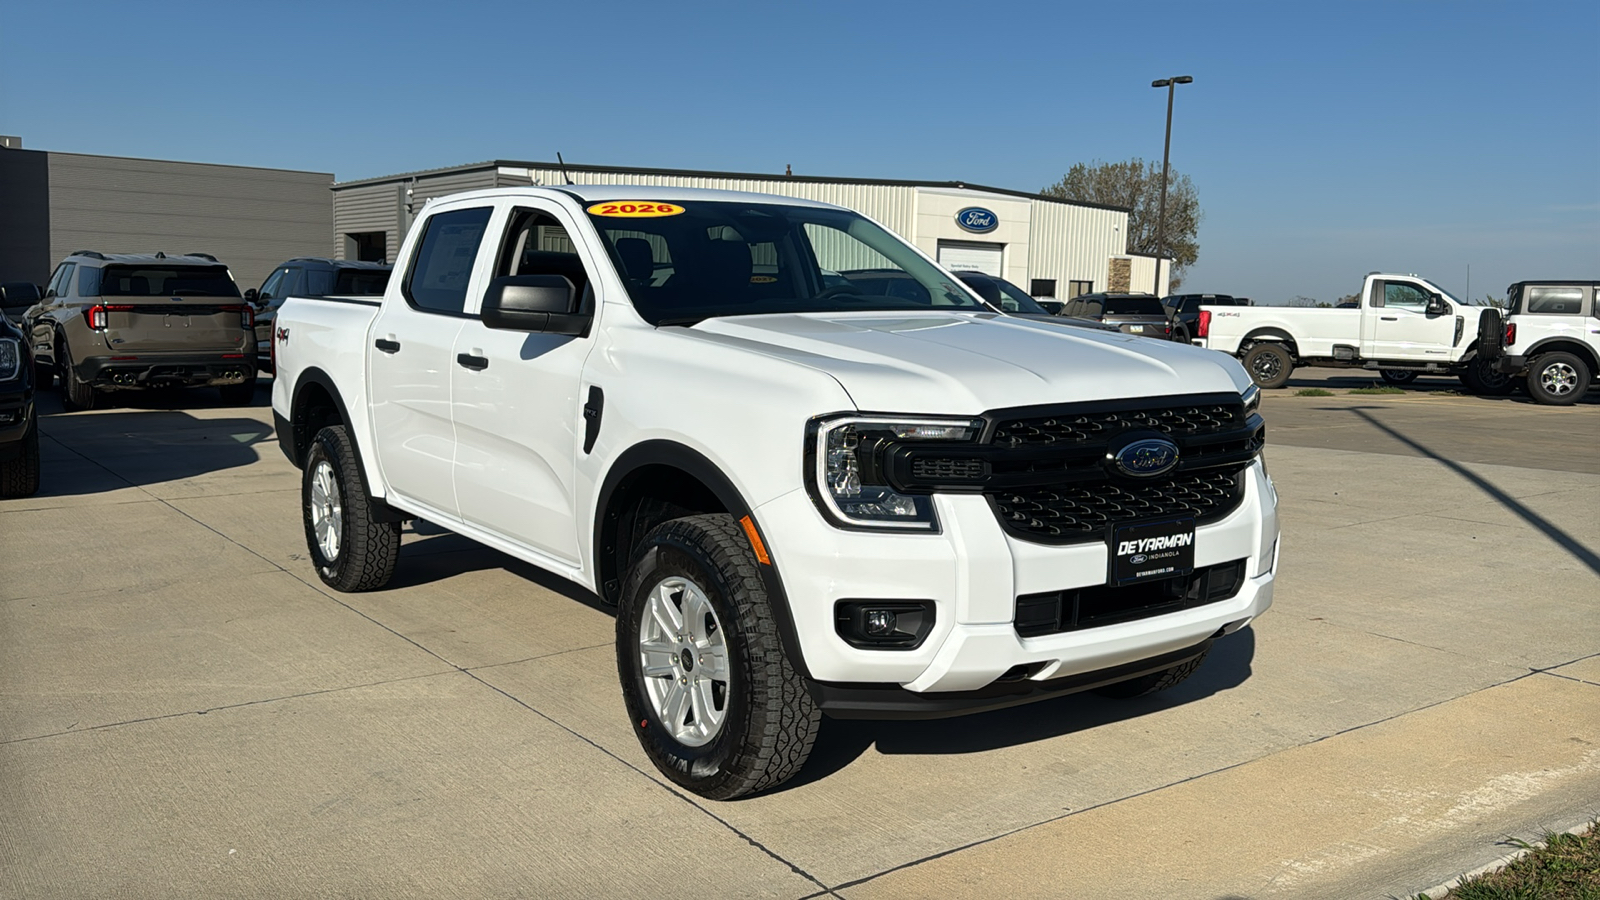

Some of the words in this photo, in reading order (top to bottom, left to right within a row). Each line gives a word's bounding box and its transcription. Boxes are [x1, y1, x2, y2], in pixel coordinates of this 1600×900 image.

[601, 204, 674, 214] 2026
[966, 211, 991, 226] Ford
[1133, 447, 1167, 468] Ford
[1117, 532, 1193, 556] DEYARMAN
[1148, 550, 1180, 560] INDIANOLA
[1136, 567, 1174, 577] DEYARMANFORD.COM
